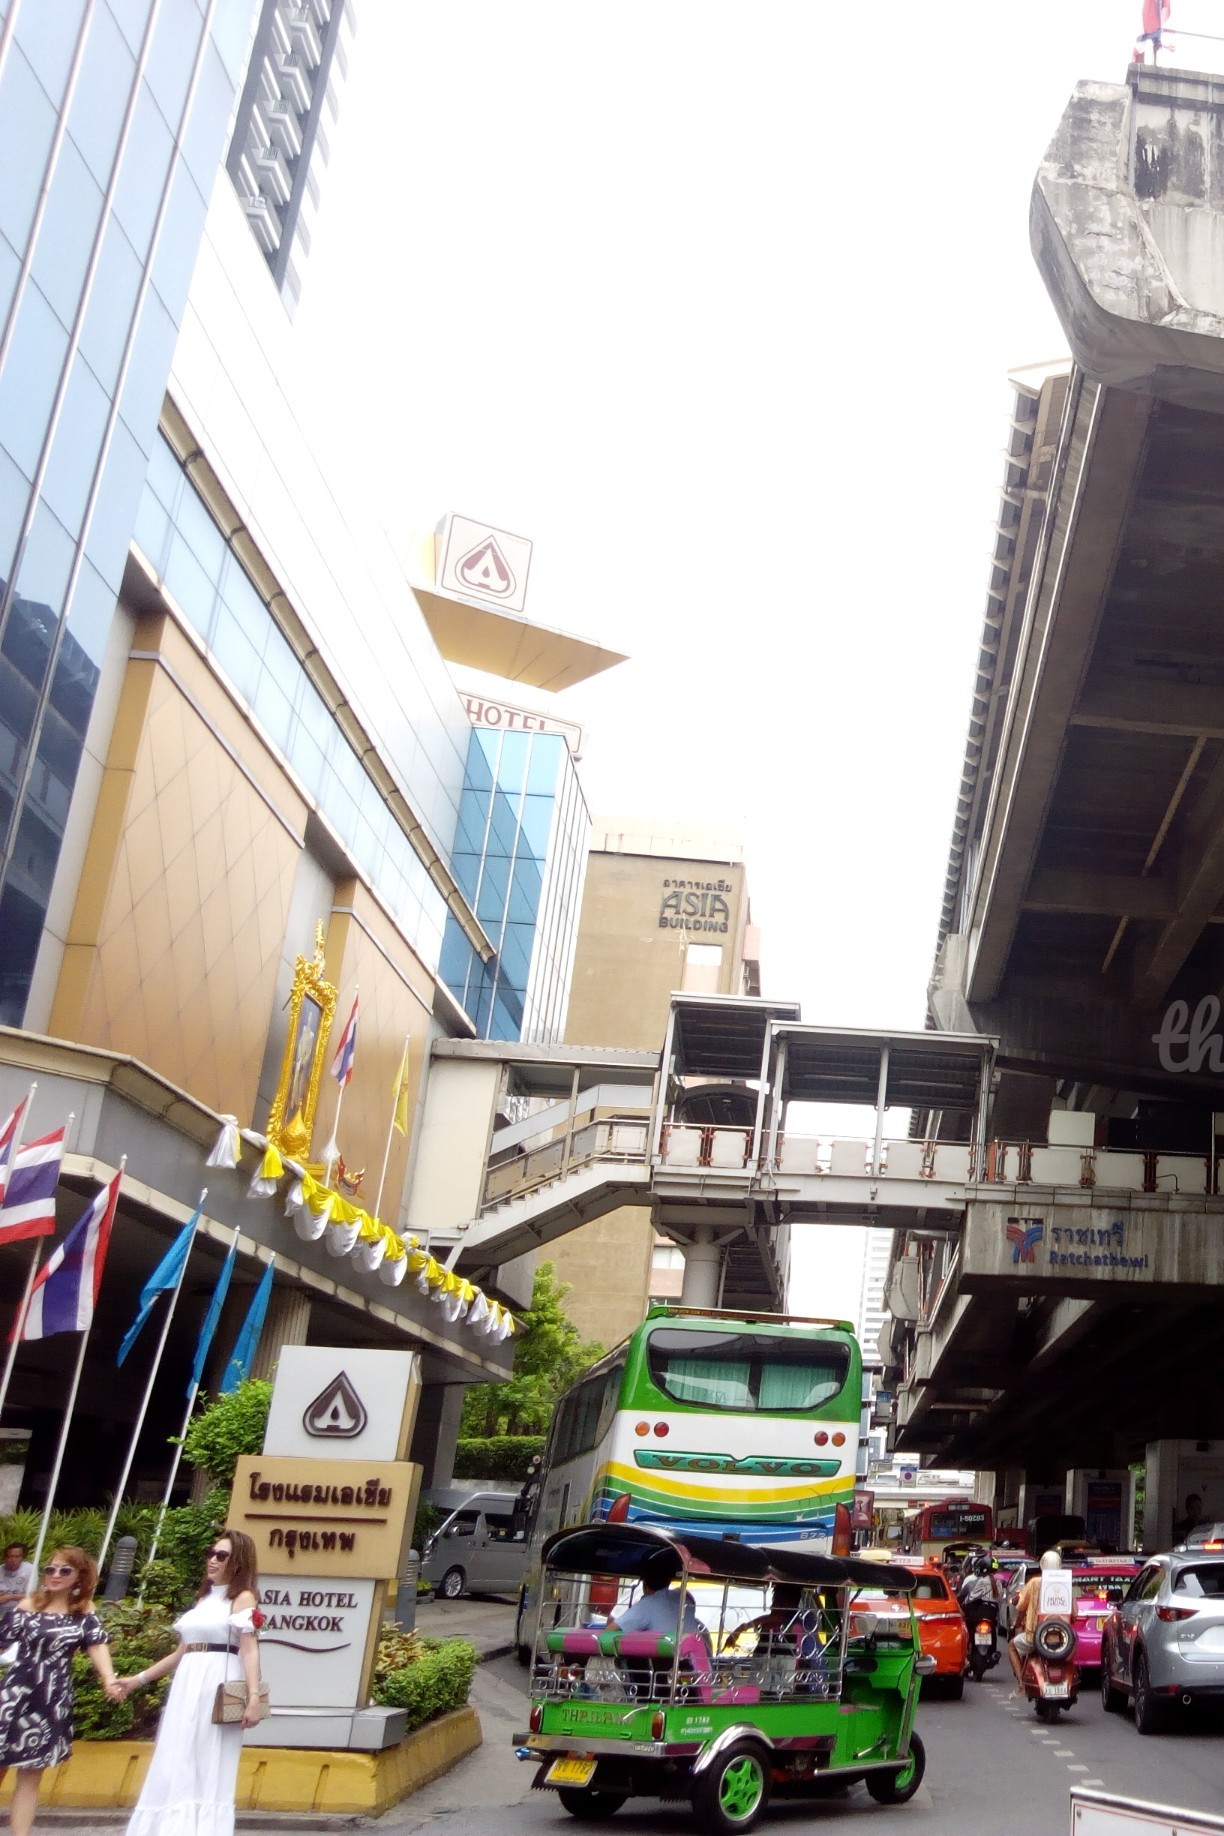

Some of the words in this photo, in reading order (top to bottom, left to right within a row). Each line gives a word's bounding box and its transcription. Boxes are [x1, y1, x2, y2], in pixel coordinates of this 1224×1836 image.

[663, 879, 732, 893] อาคารเอเชีย
[660, 890, 729, 922] ASIA
[658, 917, 728, 933] BUILDING
[1051, 1220, 1124, 1247] ราชเทวี
[652, 1454, 822, 1475] VOLVO
[249, 1472, 392, 1506] โรงแรมเอเชีย
[269, 1528, 356, 1559] กรุงเทพ
[298, 1592, 358, 1608] HOTEL
